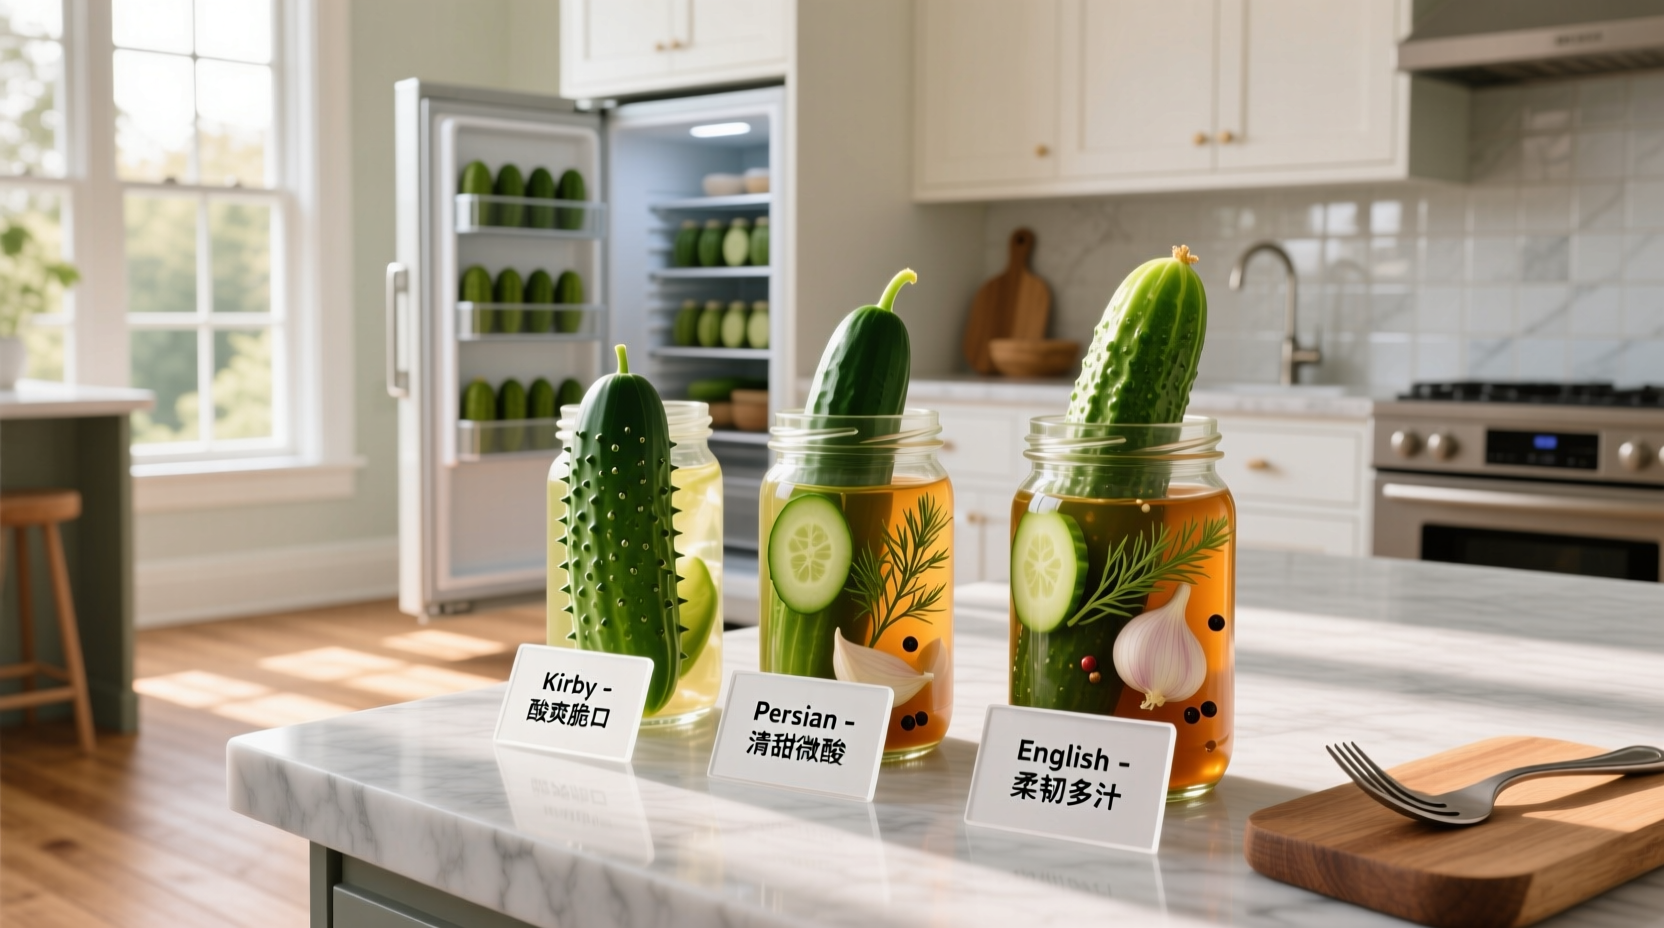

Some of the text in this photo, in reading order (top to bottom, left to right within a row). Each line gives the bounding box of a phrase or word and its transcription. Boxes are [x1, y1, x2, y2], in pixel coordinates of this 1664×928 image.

[542, 671, 598, 701] Kirby
[526, 698, 611, 729] 酸爽脆口
[753, 700, 837, 730] Persian
[746, 730, 847, 766] 清甜微酸
[1017, 738, 1110, 772] English
[1009, 771, 1122, 811] 柔韧多汁
